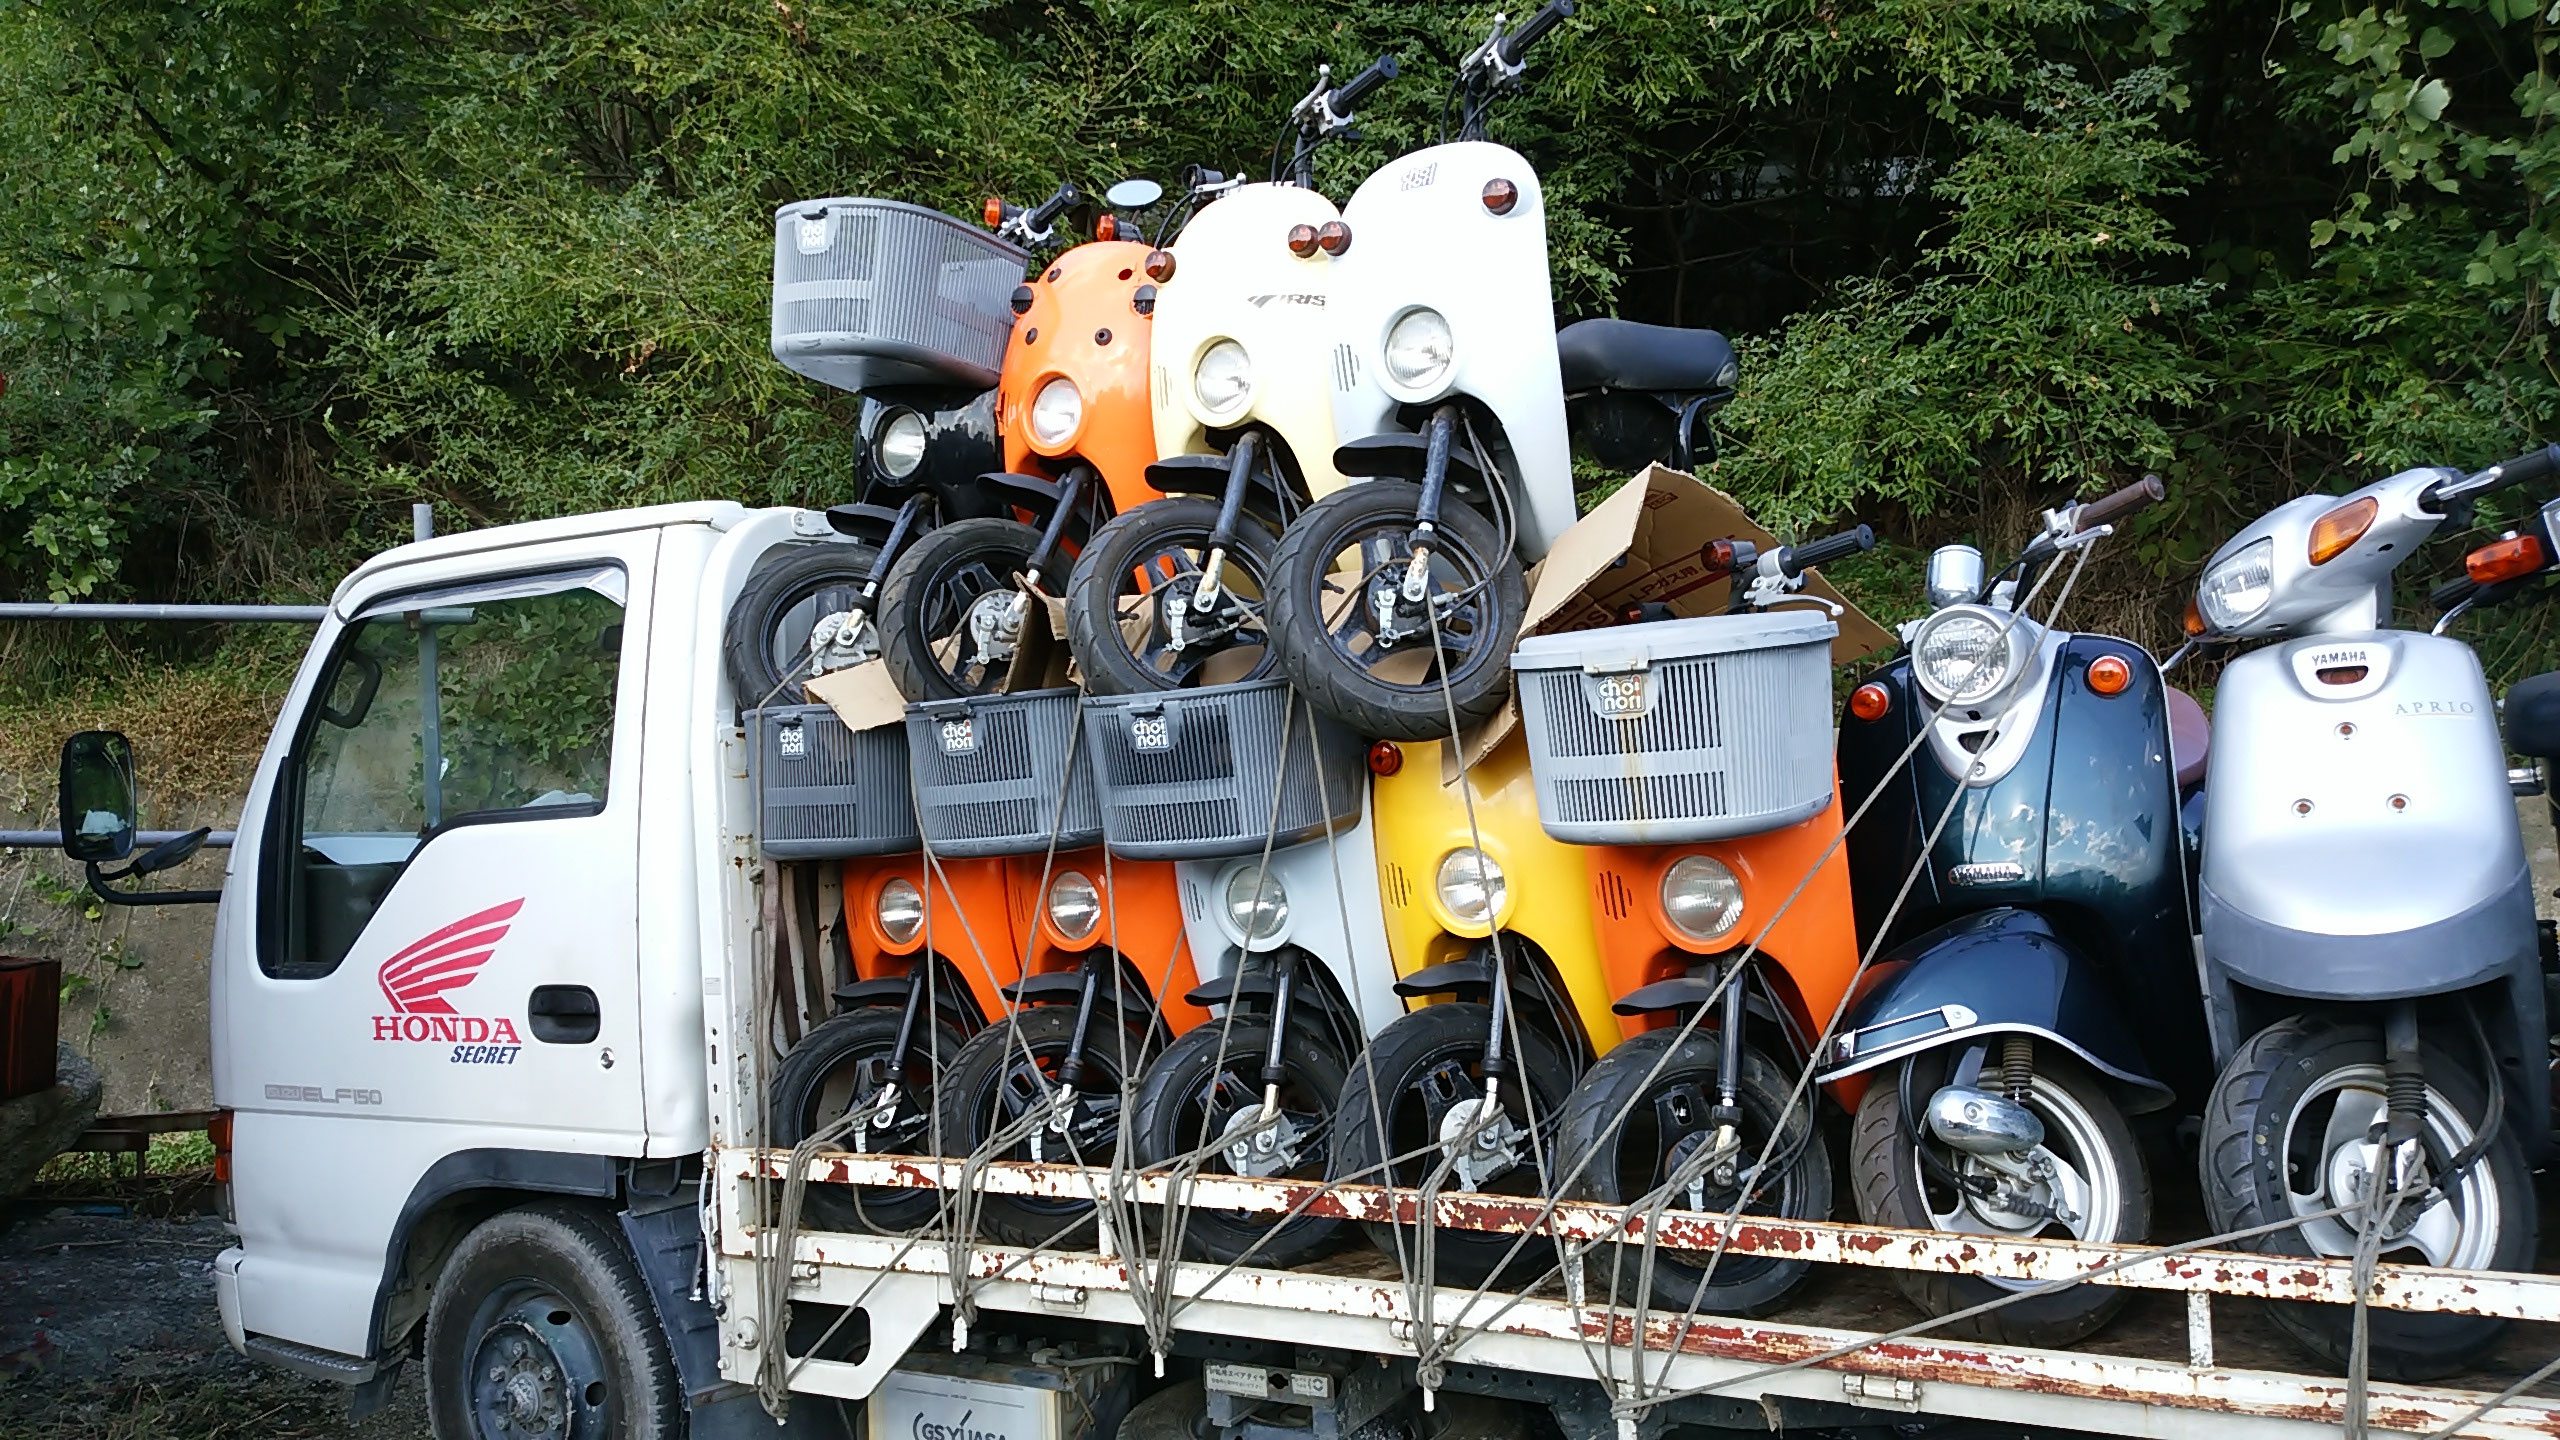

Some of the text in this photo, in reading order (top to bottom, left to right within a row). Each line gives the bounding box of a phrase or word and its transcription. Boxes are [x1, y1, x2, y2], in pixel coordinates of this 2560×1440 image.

[1628, 565, 1699, 601] LPガス用
[2312, 651, 2367, 666] YAMAHA
[1599, 676, 1641, 697] choi
[1604, 690, 1641, 711] nori
[2395, 701, 2474, 715] APRIO
[780, 726, 803, 743] choi
[943, 719, 971, 739] choi
[1133, 717, 1166, 735] choi
[782, 741, 804, 755] nori
[946, 733, 973, 750] nori
[1137, 732, 1167, 748] nori
[371, 1015, 522, 1044] HONDA
[450, 1045, 522, 1064] SECRET
